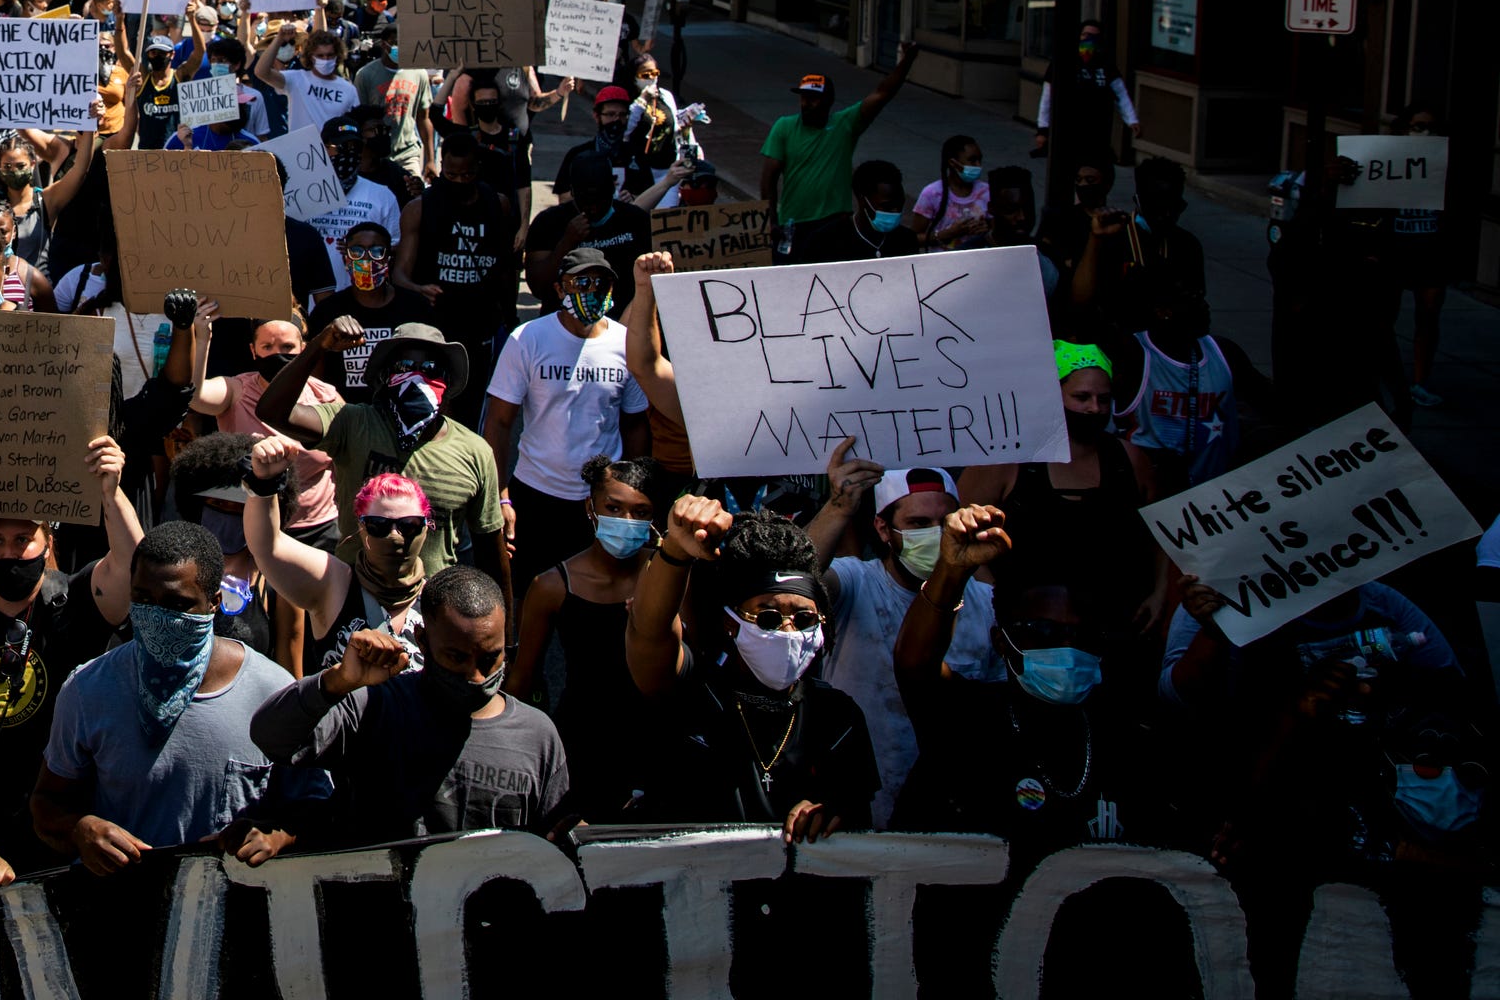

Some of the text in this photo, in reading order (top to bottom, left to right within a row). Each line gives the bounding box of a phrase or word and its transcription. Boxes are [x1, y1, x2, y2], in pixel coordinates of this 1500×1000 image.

[28, 21, 98, 47] CHANGE!
[431, 13, 504, 39] LIVES
[411, 37, 514, 63] MATTER
[53, 73, 98, 95] HATE!
[181, 79, 223, 100] SILENCE
[307, 83, 344, 103] NIKE
[189, 93, 236, 113] VIOLENCE
[231, 168, 276, 185] MATTER
[122, 254, 284, 286] Peace later
[698, 263, 976, 343] BLACK
[25, 320, 62, 339] Floyd
[33, 339, 82, 360] Arbery
[38, 362, 85, 380] Taylor
[759, 333, 970, 390] LIVES
[539, 365, 625, 383] LIVE UNITED
[22, 384, 63, 398] Brown
[22, 429, 67, 445] Martin
[744, 390, 1022, 463] MATTER!!!
[7, 452, 58, 476] Sterling
[25, 475, 84, 495] DuBose
[1155, 427, 1400, 550] White silence
[33, 498, 94, 519] Castille
[1259, 520, 1309, 553] is
[473, 763, 530, 795] DREAM
